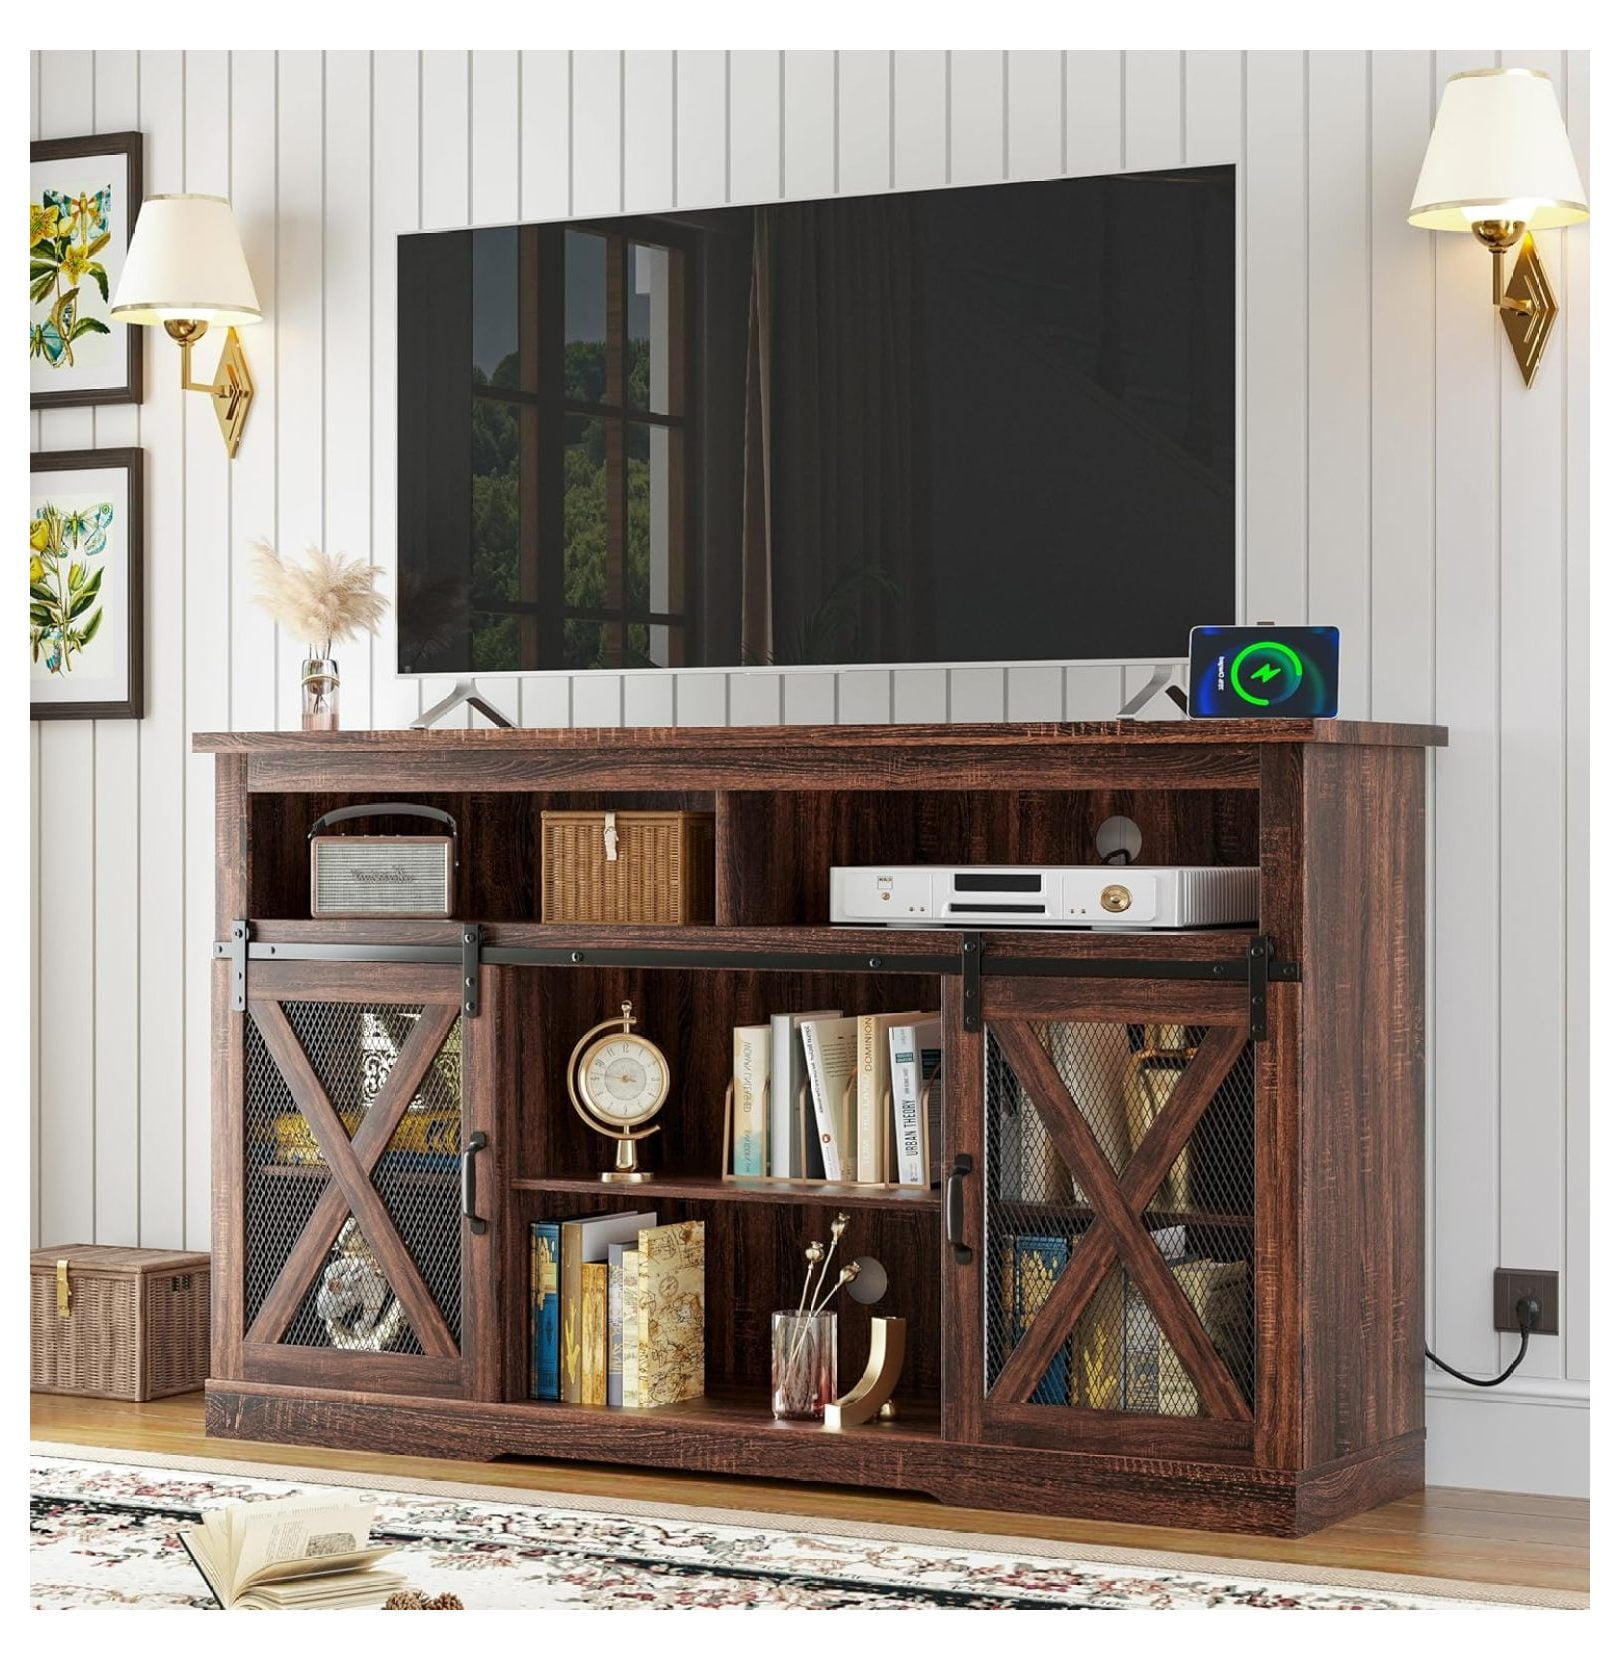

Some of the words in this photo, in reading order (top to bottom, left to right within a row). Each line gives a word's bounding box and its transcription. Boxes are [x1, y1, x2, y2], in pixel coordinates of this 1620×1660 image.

[864, 1017, 873, 1072] DOMINION
[903, 1099, 917, 1128] THEORY
[906, 1130, 918, 1157] URBAN
